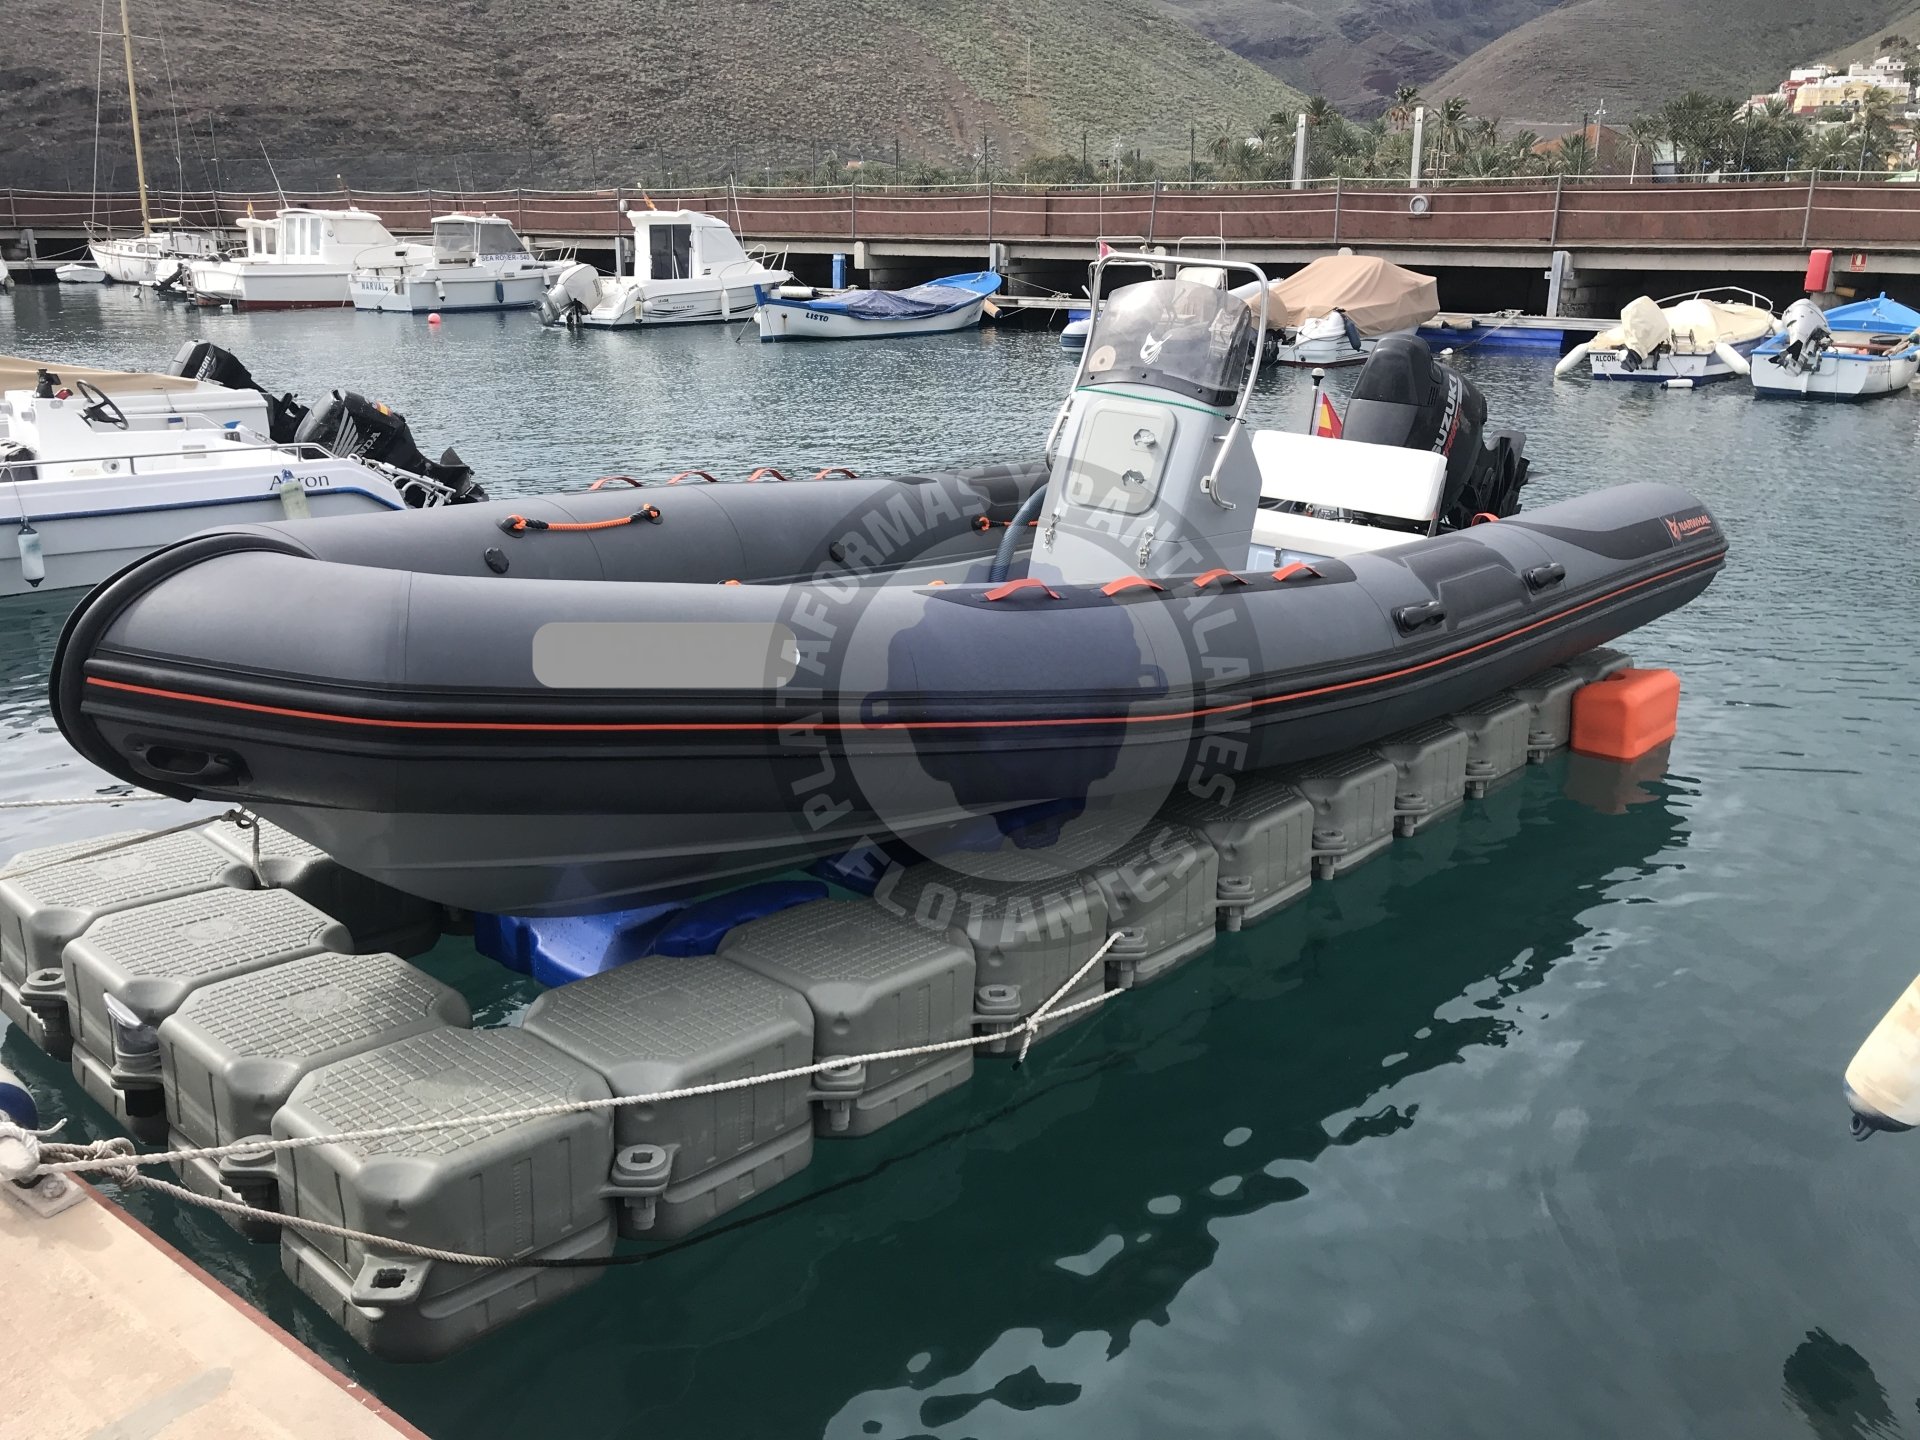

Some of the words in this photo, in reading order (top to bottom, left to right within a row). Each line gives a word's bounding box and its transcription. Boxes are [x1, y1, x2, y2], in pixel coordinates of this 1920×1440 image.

[361, 281, 386, 291] NARVAL
[806, 312, 829, 322] LISTO
[195, 355, 211, 380] nson
[355, 432, 381, 457] NDA
[269, 475, 330, 491] Aron
[1677, 514, 1711, 531] NARWHAL
